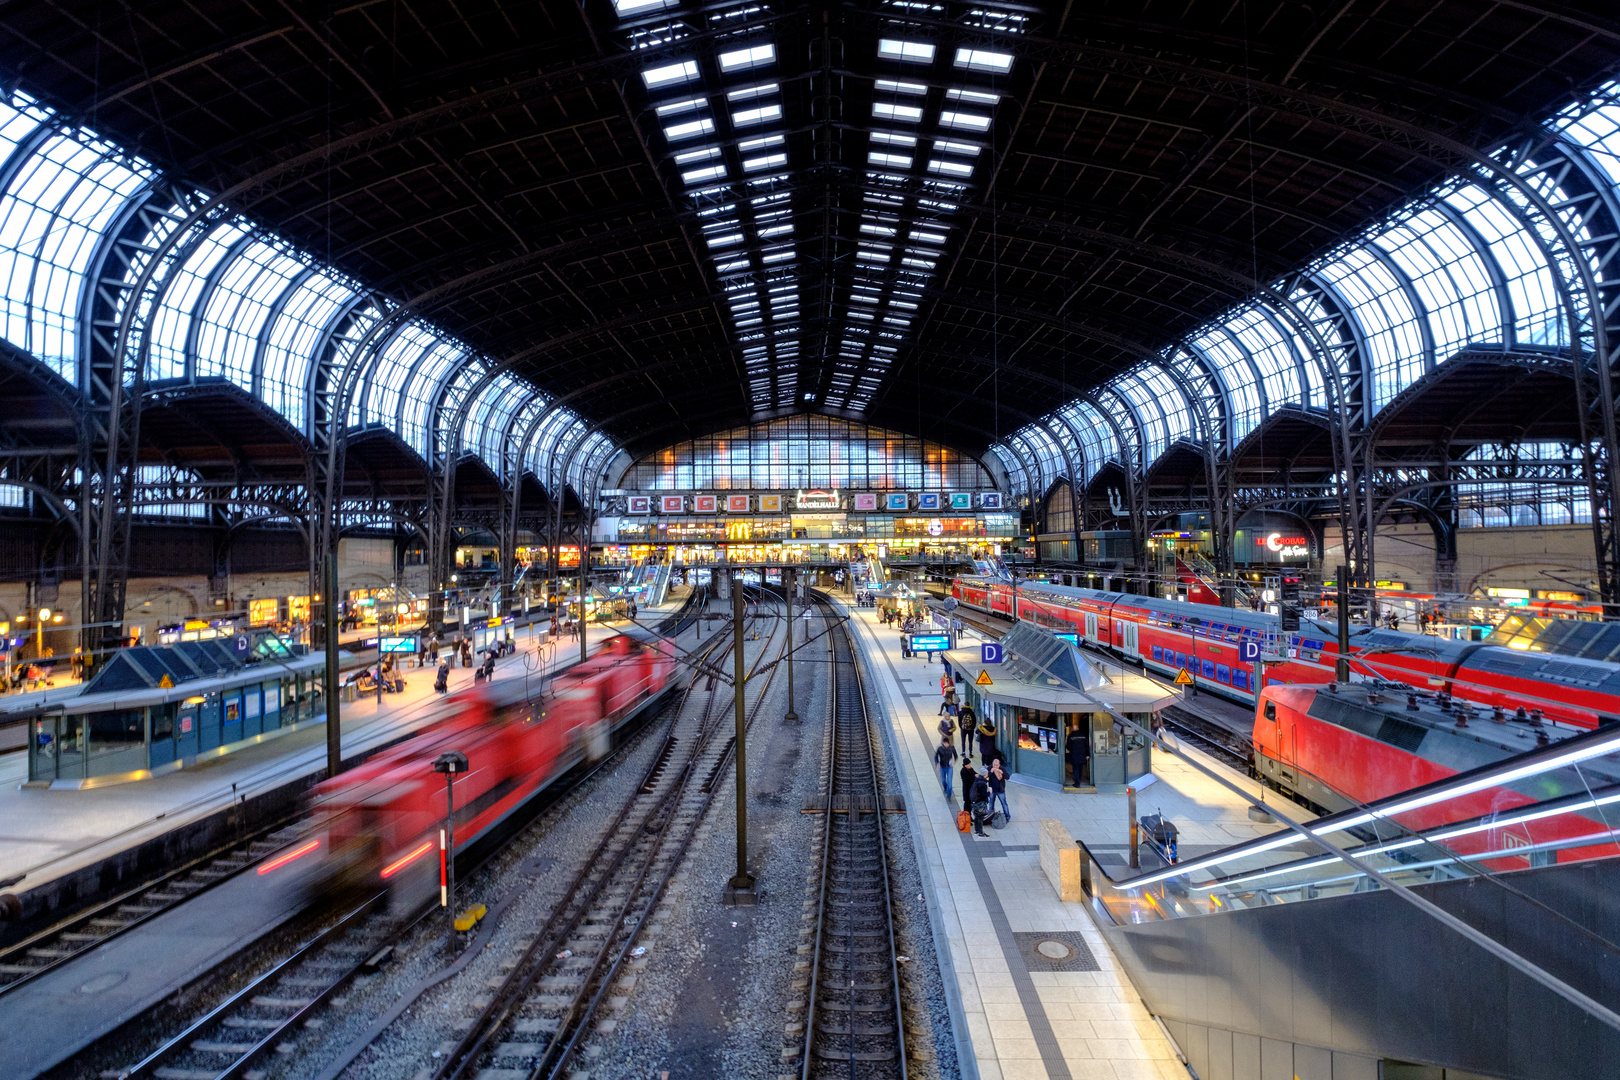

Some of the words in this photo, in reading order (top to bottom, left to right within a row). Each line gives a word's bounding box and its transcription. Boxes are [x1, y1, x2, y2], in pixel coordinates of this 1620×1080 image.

[1256, 537, 1266, 546] LE
[238, 637, 247, 650] D
[1246, 642, 1258, 658] D
[985, 645, 997, 661] D
